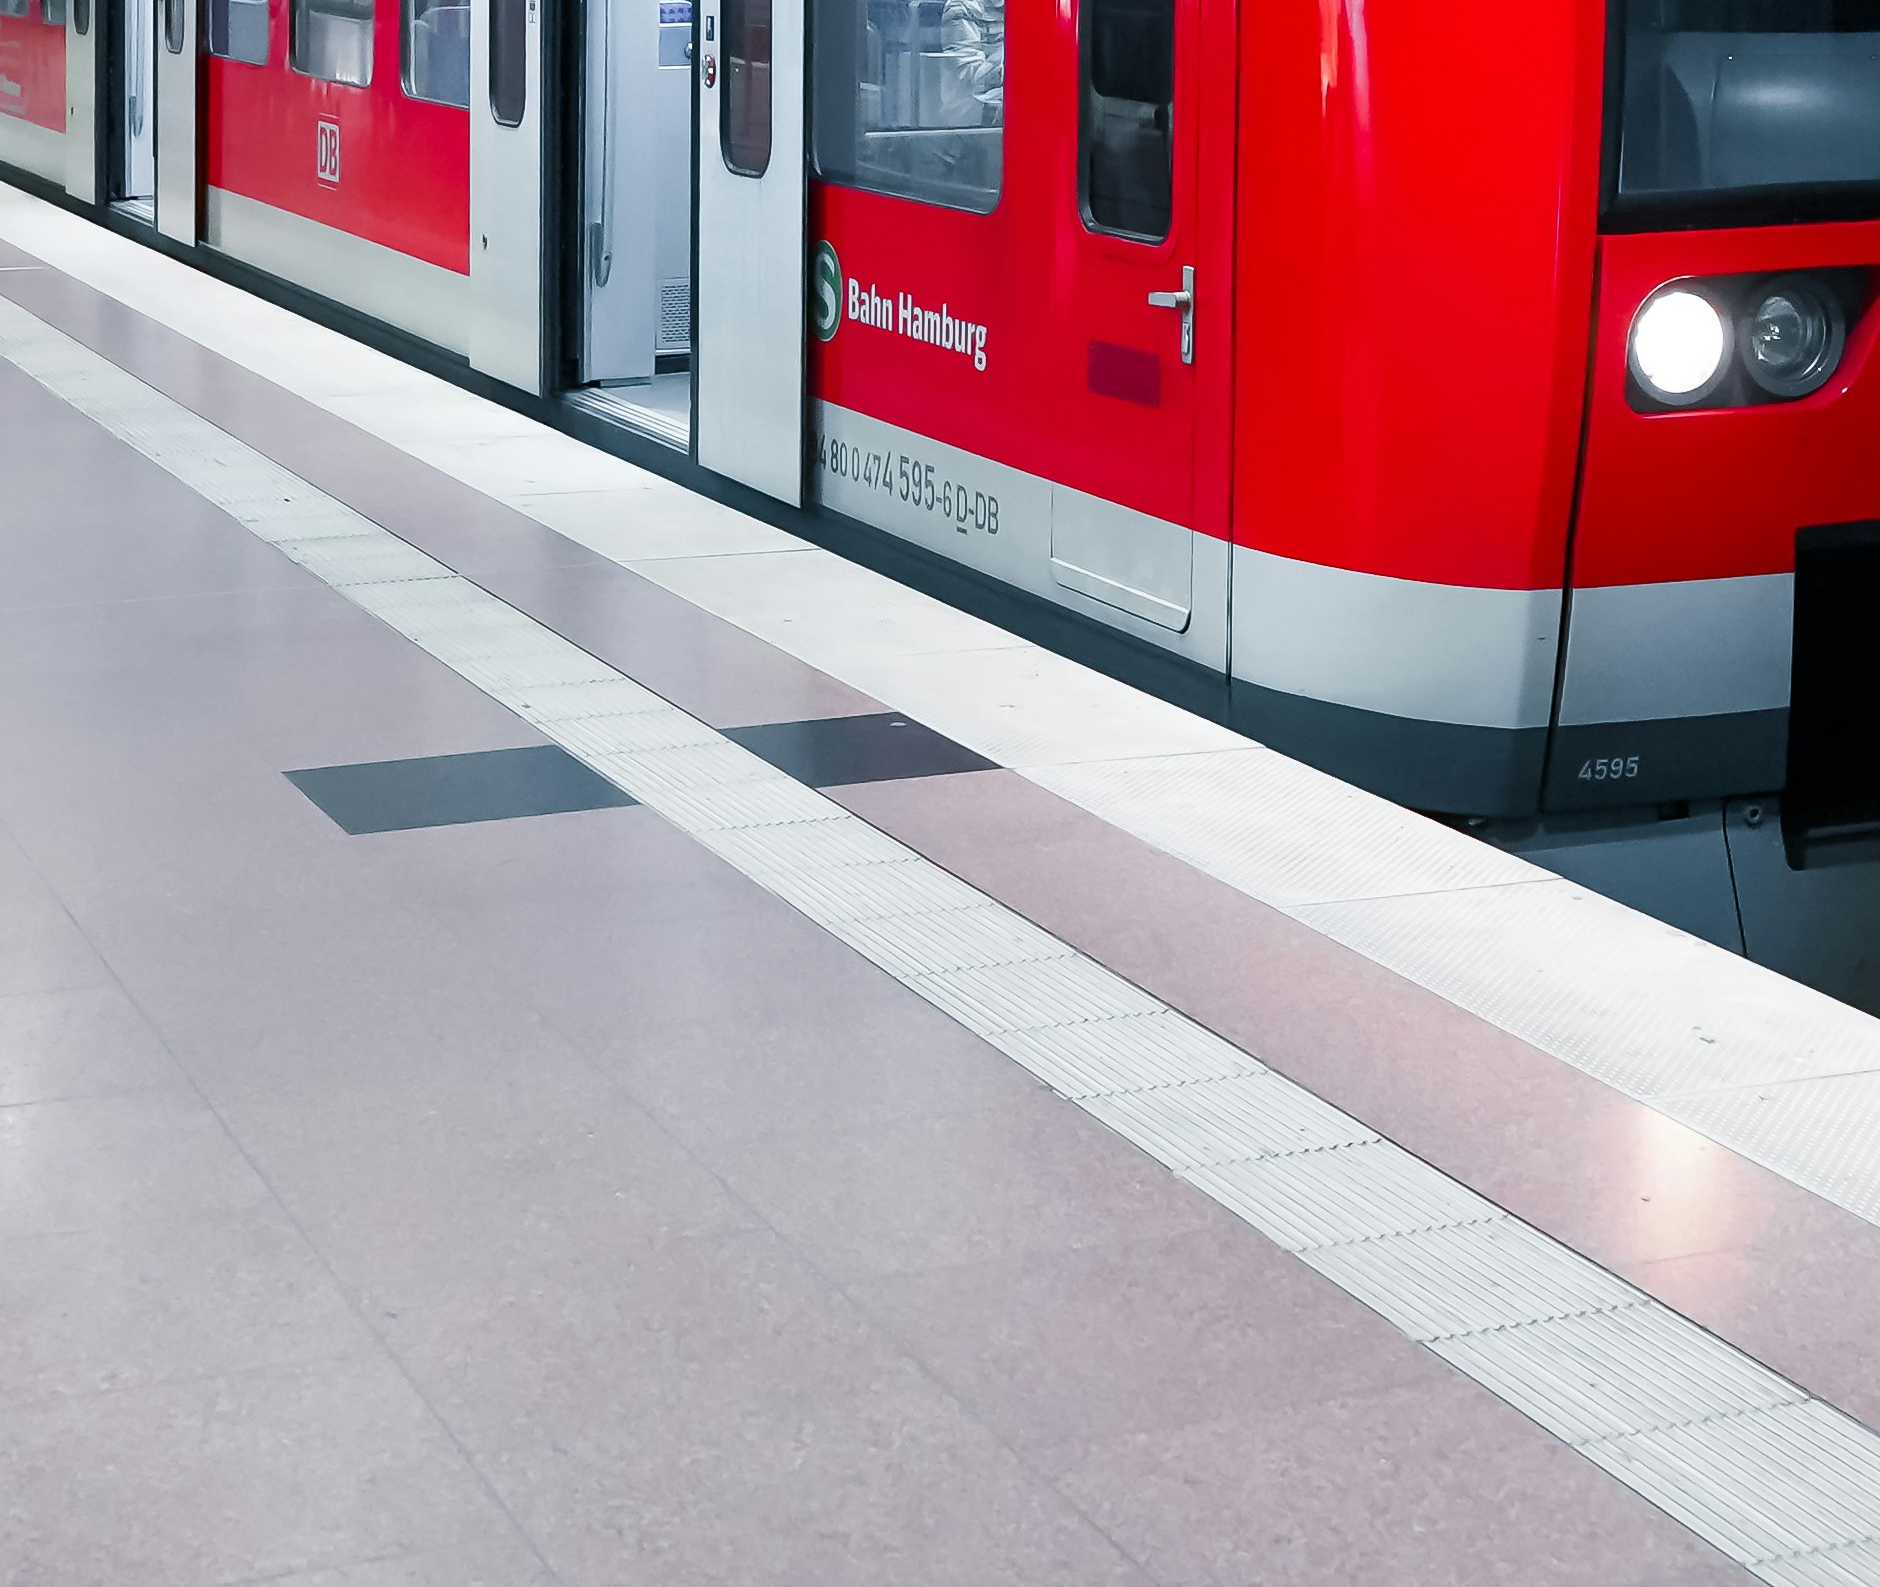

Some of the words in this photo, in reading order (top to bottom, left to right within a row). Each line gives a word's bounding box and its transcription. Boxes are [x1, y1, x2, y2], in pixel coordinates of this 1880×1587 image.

[319, 125, 338, 176] DB
[847, 277, 893, 332] Bahn
[897, 291, 988, 372] Hamburg
[956, 484, 999, 535] D-DB
[1577, 756, 1640, 782] 4595
